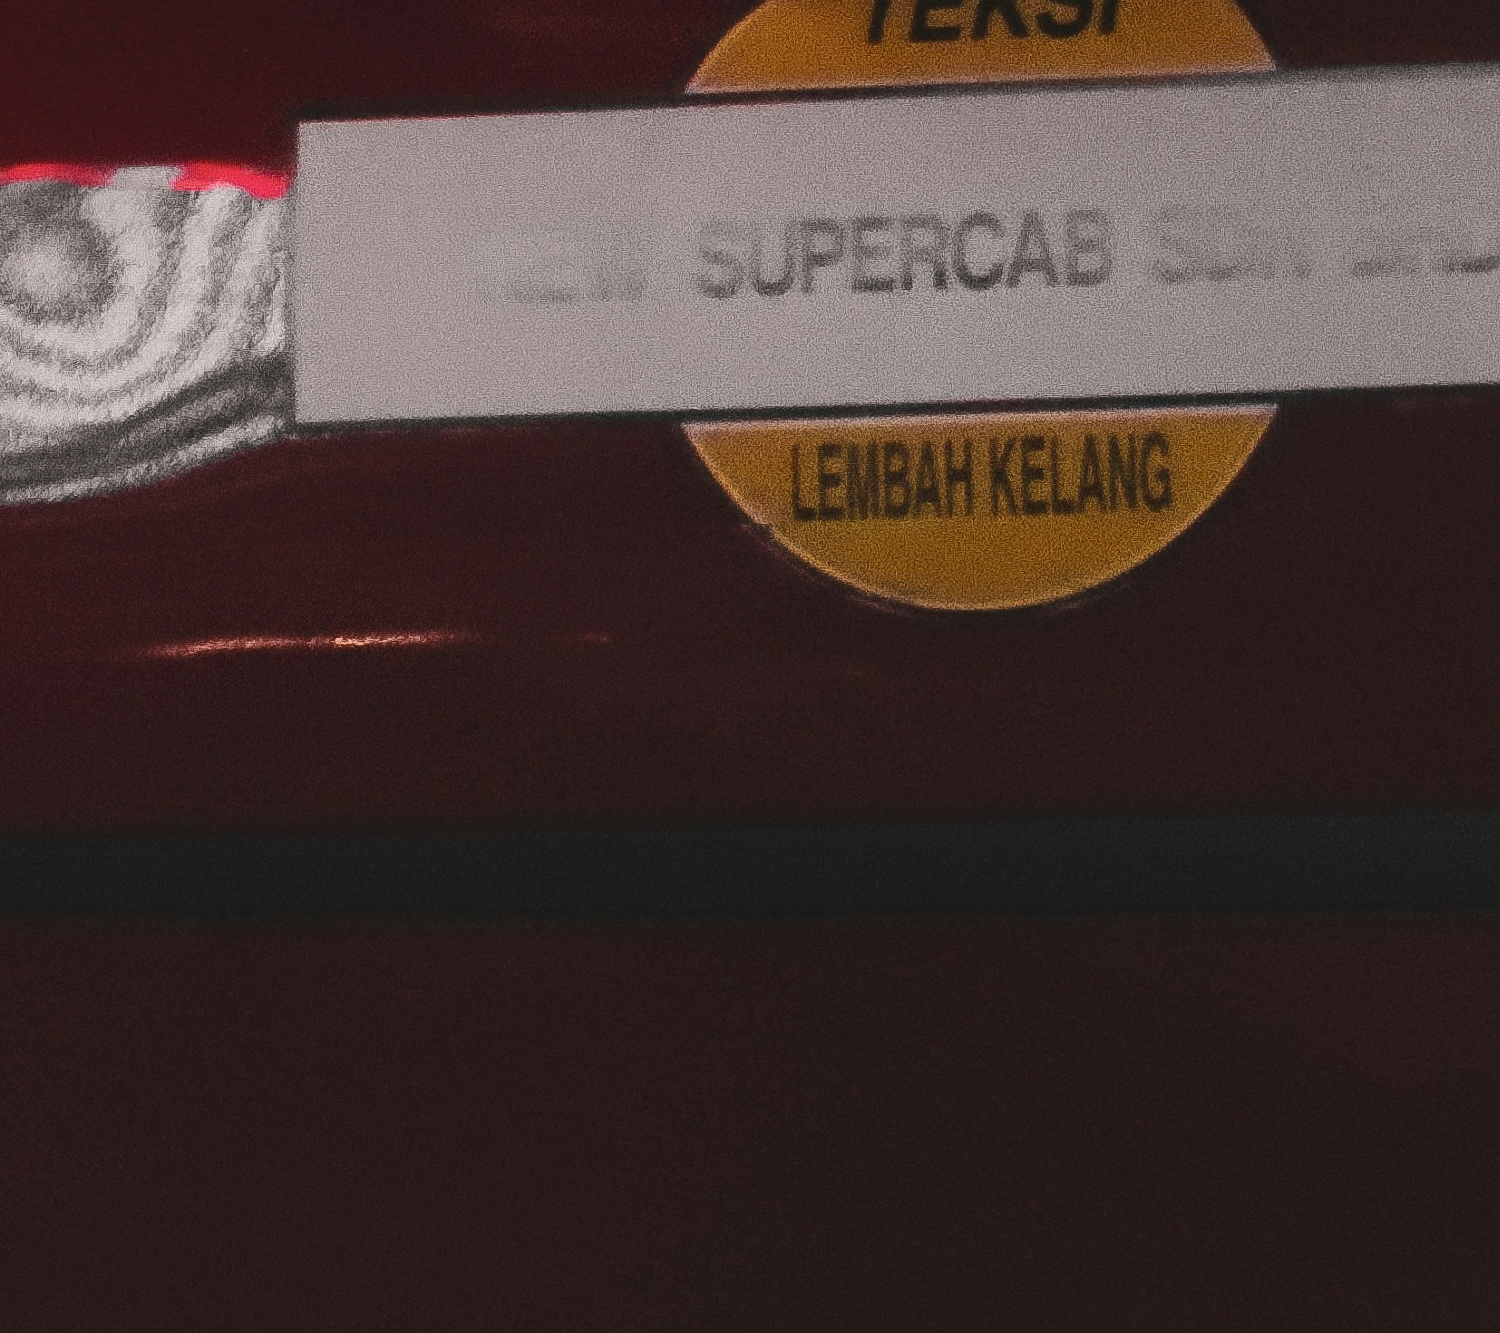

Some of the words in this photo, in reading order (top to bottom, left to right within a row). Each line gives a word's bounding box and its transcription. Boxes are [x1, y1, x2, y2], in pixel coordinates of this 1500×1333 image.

[696, 209, 1113, 299] SUPERCAB
[791, 437, 973, 522] LEMBAH
[989, 433, 1173, 517] KELANG
